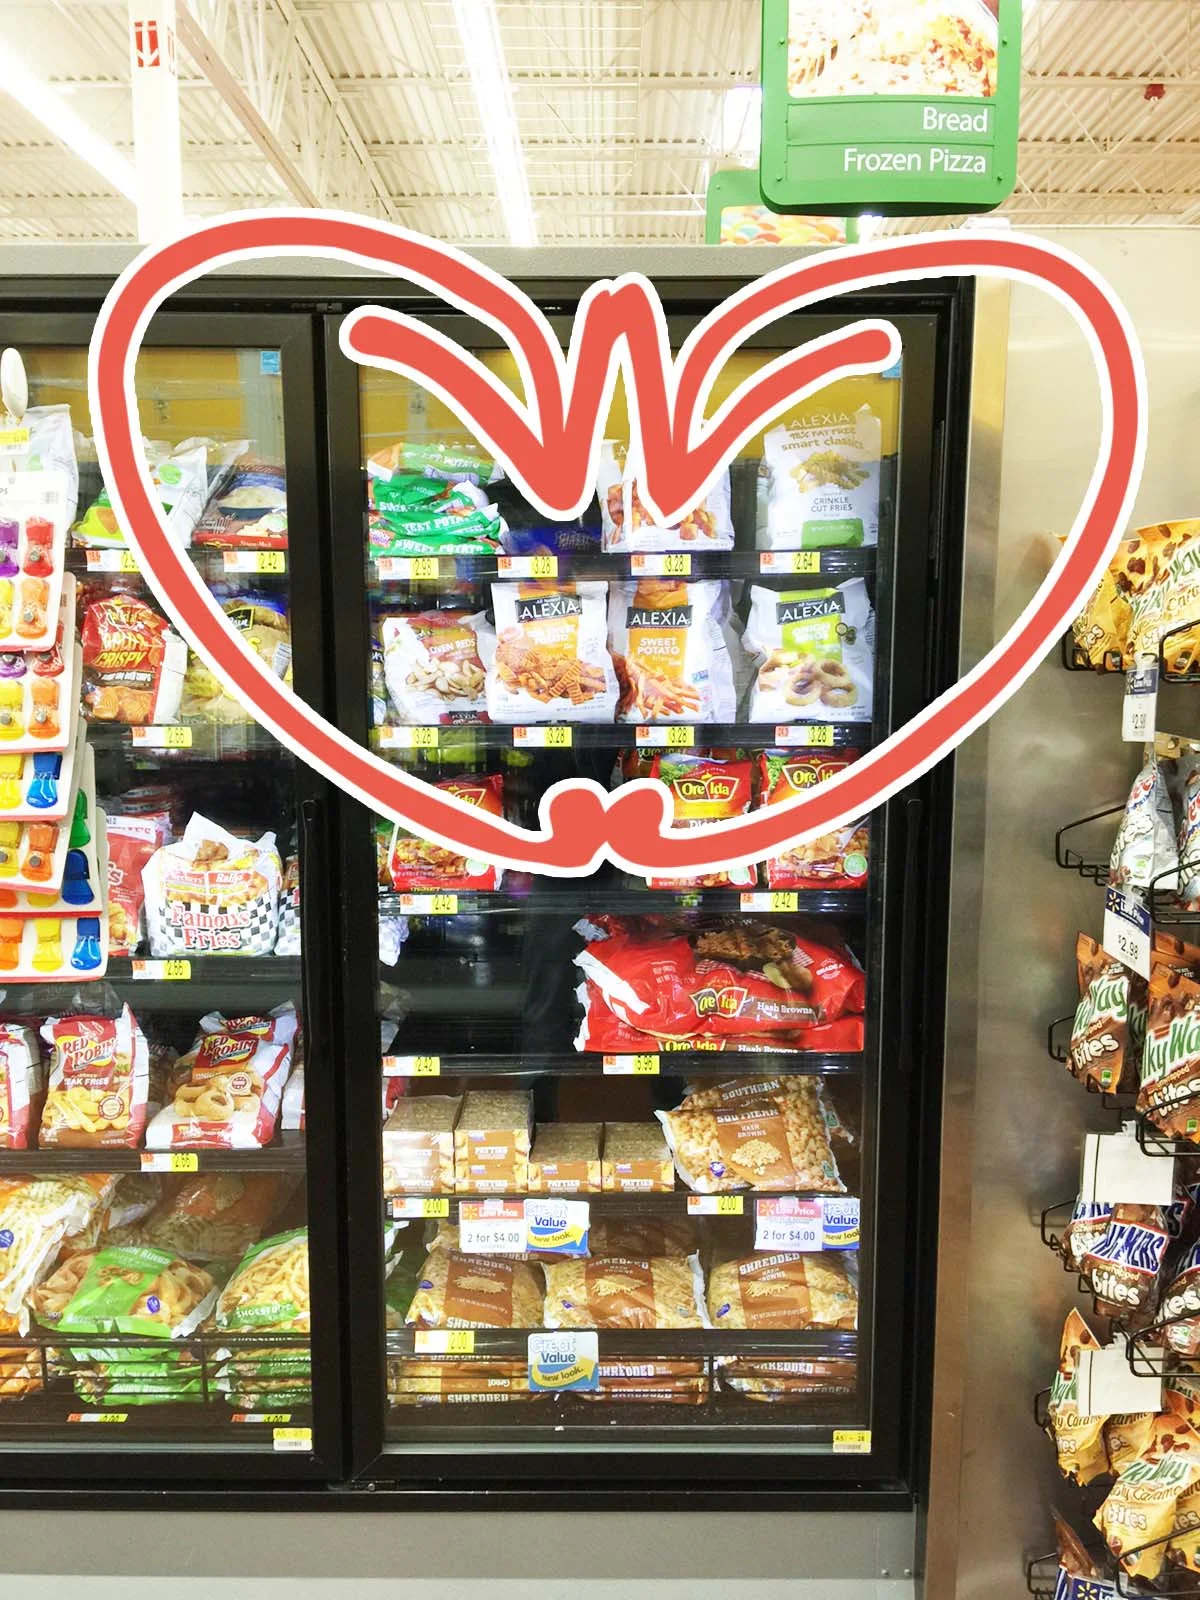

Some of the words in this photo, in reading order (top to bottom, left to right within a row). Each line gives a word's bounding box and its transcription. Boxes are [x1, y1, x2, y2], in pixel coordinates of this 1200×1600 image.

[923, 106, 988, 133] Bread
[844, 148, 921, 173] Frozen
[930, 148, 986, 173] Pizza
[791, 412, 849, 428] ALEXIA
[781, 439, 820, 451] smart
[811, 505, 828, 513] CUT
[830, 504, 853, 512] FRIES
[813, 497, 849, 505] CRINKLE
[519, 600, 579, 621] ALEXIA
[631, 611, 687, 625] ALEXIA
[780, 601, 840, 622] ALEXIA
[639, 638, 677, 646] SWEET
[637, 646, 680, 655] POTATO
[94, 651, 147, 668] CRISPY
[792, 769, 816, 785] Ore
[682, 783, 706, 795] Ore
[710, 783, 730, 796] Ida
[171, 904, 251, 928] Famous
[183, 928, 240, 950] Fries
[1117, 934, 1139, 960] $2.98
[720, 995, 738, 1012] Ida
[1089, 979, 1128, 1018] Way
[757, 1002, 780, 1013] Hash
[781, 1004, 813, 1015] Browns
[63, 1037, 88, 1054] RED
[73, 1039, 117, 1067] ROBIN
[211, 1040, 256, 1062] ROBIN
[1073, 1033, 1120, 1070] bites
[84, 1077, 109, 1086] FRIES
[721, 1080, 780, 1101] SOUTHERN
[496, 1207, 518, 1217] Price
[794, 1206, 815, 1216] Price
[534, 1216, 567, 1227] Value
[825, 1215, 859, 1226] Value
[467, 1234, 473, 1242] 2
[476, 1233, 490, 1242] for
[493, 1232, 520, 1243] $4.00
[763, 1231, 769, 1240] 2
[772, 1230, 787, 1240] for
[789, 1229, 815, 1241] $4.00
[739, 1253, 801, 1275] SHREDDED
[1091, 1268, 1141, 1306] bites
[528, 1336, 576, 1352] Great
[541, 1351, 576, 1363] Value
[541, 1373, 559, 1382] new
[598, 1364, 655, 1377] SHREDDED
[447, 1394, 509, 1403] SHREDDED
